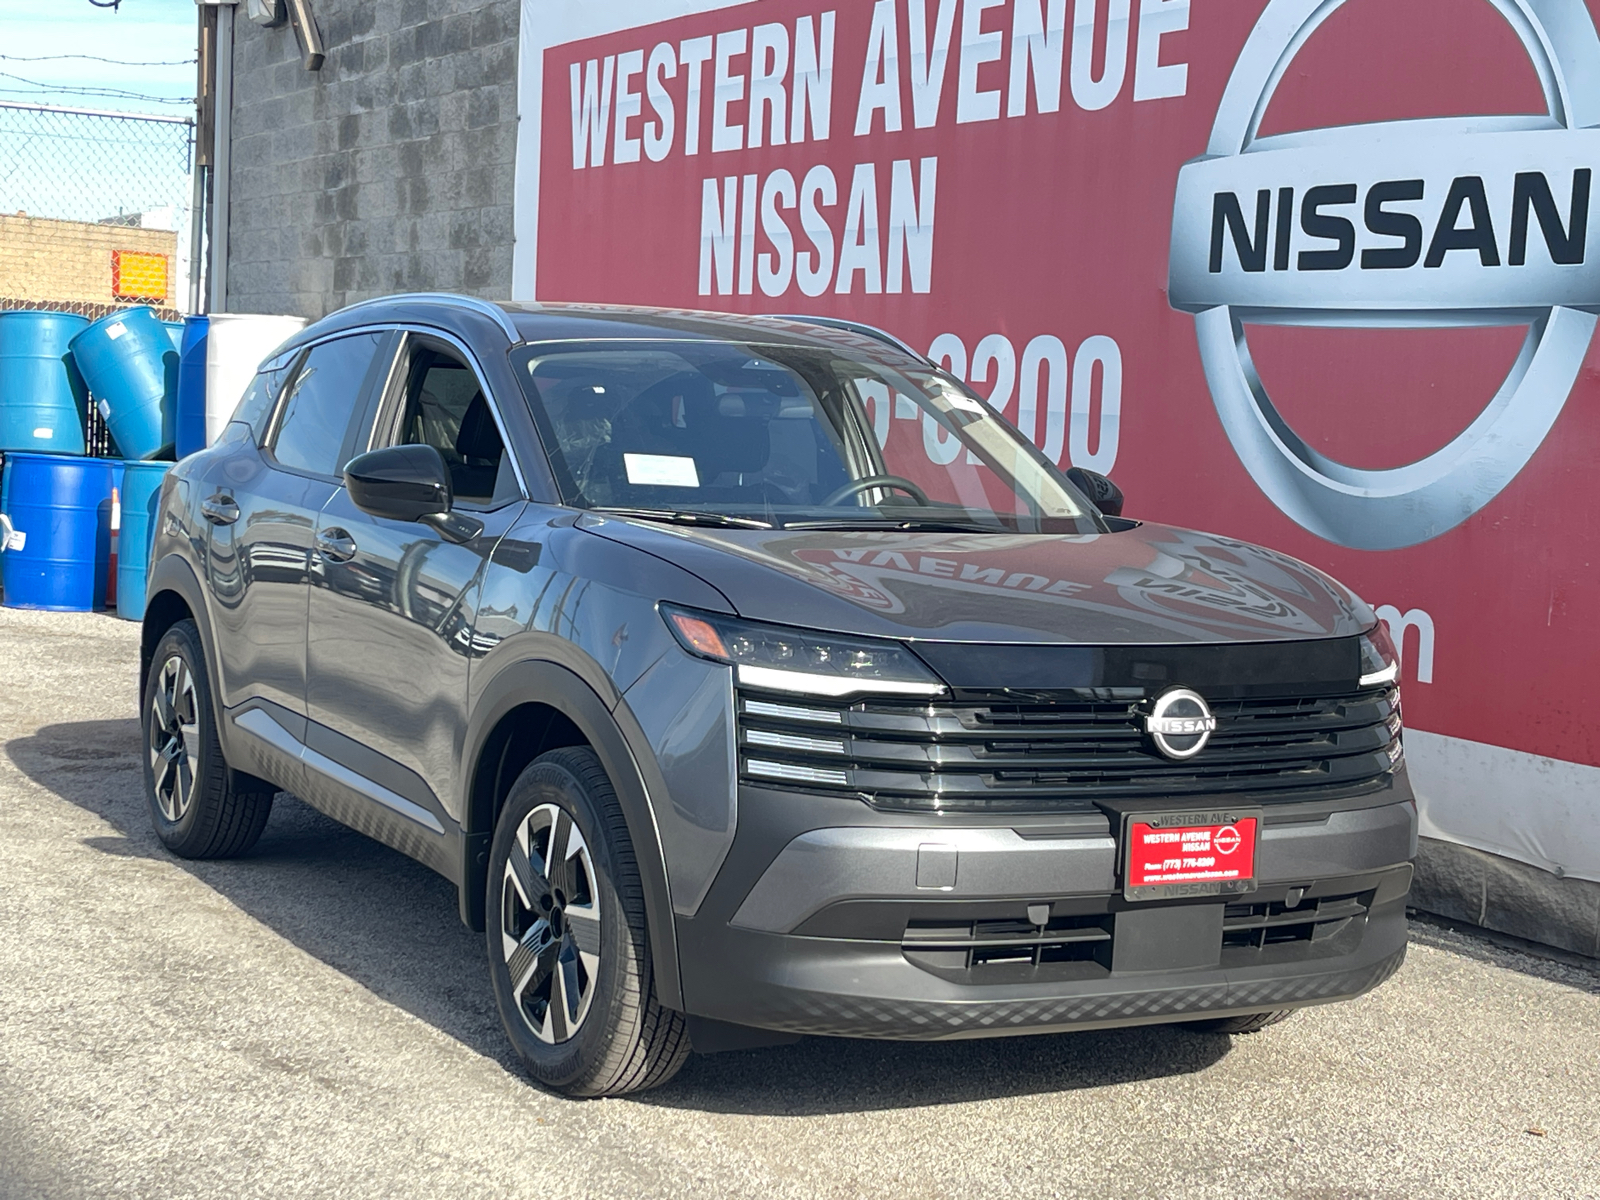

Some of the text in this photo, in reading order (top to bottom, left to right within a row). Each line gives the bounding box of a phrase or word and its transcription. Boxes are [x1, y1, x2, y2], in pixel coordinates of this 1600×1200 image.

[570, 0, 1190, 170] WESTERN AVENUE
[698, 157, 937, 297] NISSAN
[1209, 168, 1591, 273] NISSAN
[1149, 718, 1216, 732] NISSAN
[1160, 814, 1207, 826] WESTERN
[1143, 831, 1211, 844] WESTERN AVENUE
[1182, 842, 1211, 852] NISSAN
[1164, 881, 1221, 897] NISSAN
